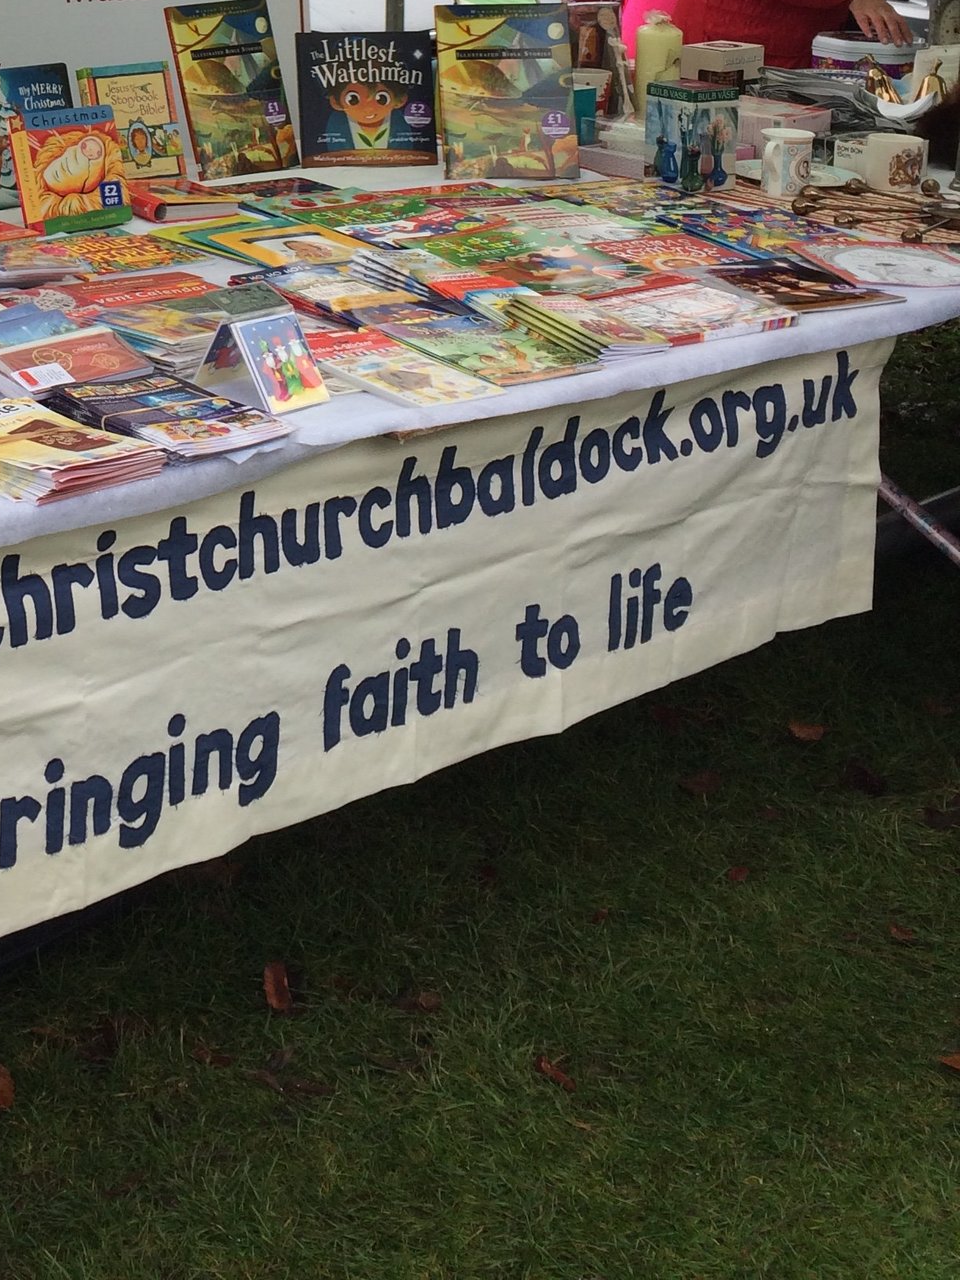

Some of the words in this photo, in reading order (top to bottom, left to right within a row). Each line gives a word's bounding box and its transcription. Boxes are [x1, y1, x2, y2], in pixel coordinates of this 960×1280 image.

[310, 51, 325, 61] The
[321, 36, 396, 63] Littlest
[311, 60, 423, 89] Watchman
[30, 82, 64, 96] MERRY
[105, 84, 130, 97] Jesus
[650, 88, 668, 97] BULB
[669, 90, 688, 99] VASE
[697, 92, 716, 100] BULB
[717, 90, 735, 99] VASE
[24, 98, 66, 111] Christmas
[111, 92, 160, 108] Storybook
[267, 101, 279, 112] £1
[139, 103, 165, 116] Bible
[410, 103, 425, 114] £2
[31, 109, 107, 128] Christmas
[547, 113, 562, 124] £1
[105, 185, 118, 196] £2
[105, 196, 119, 205] OFF
[136, 284, 209, 299] Calendar
[324, 628, 478, 752] faith
[516, 604, 580, 678] to
[608, 563, 693, 651] life
